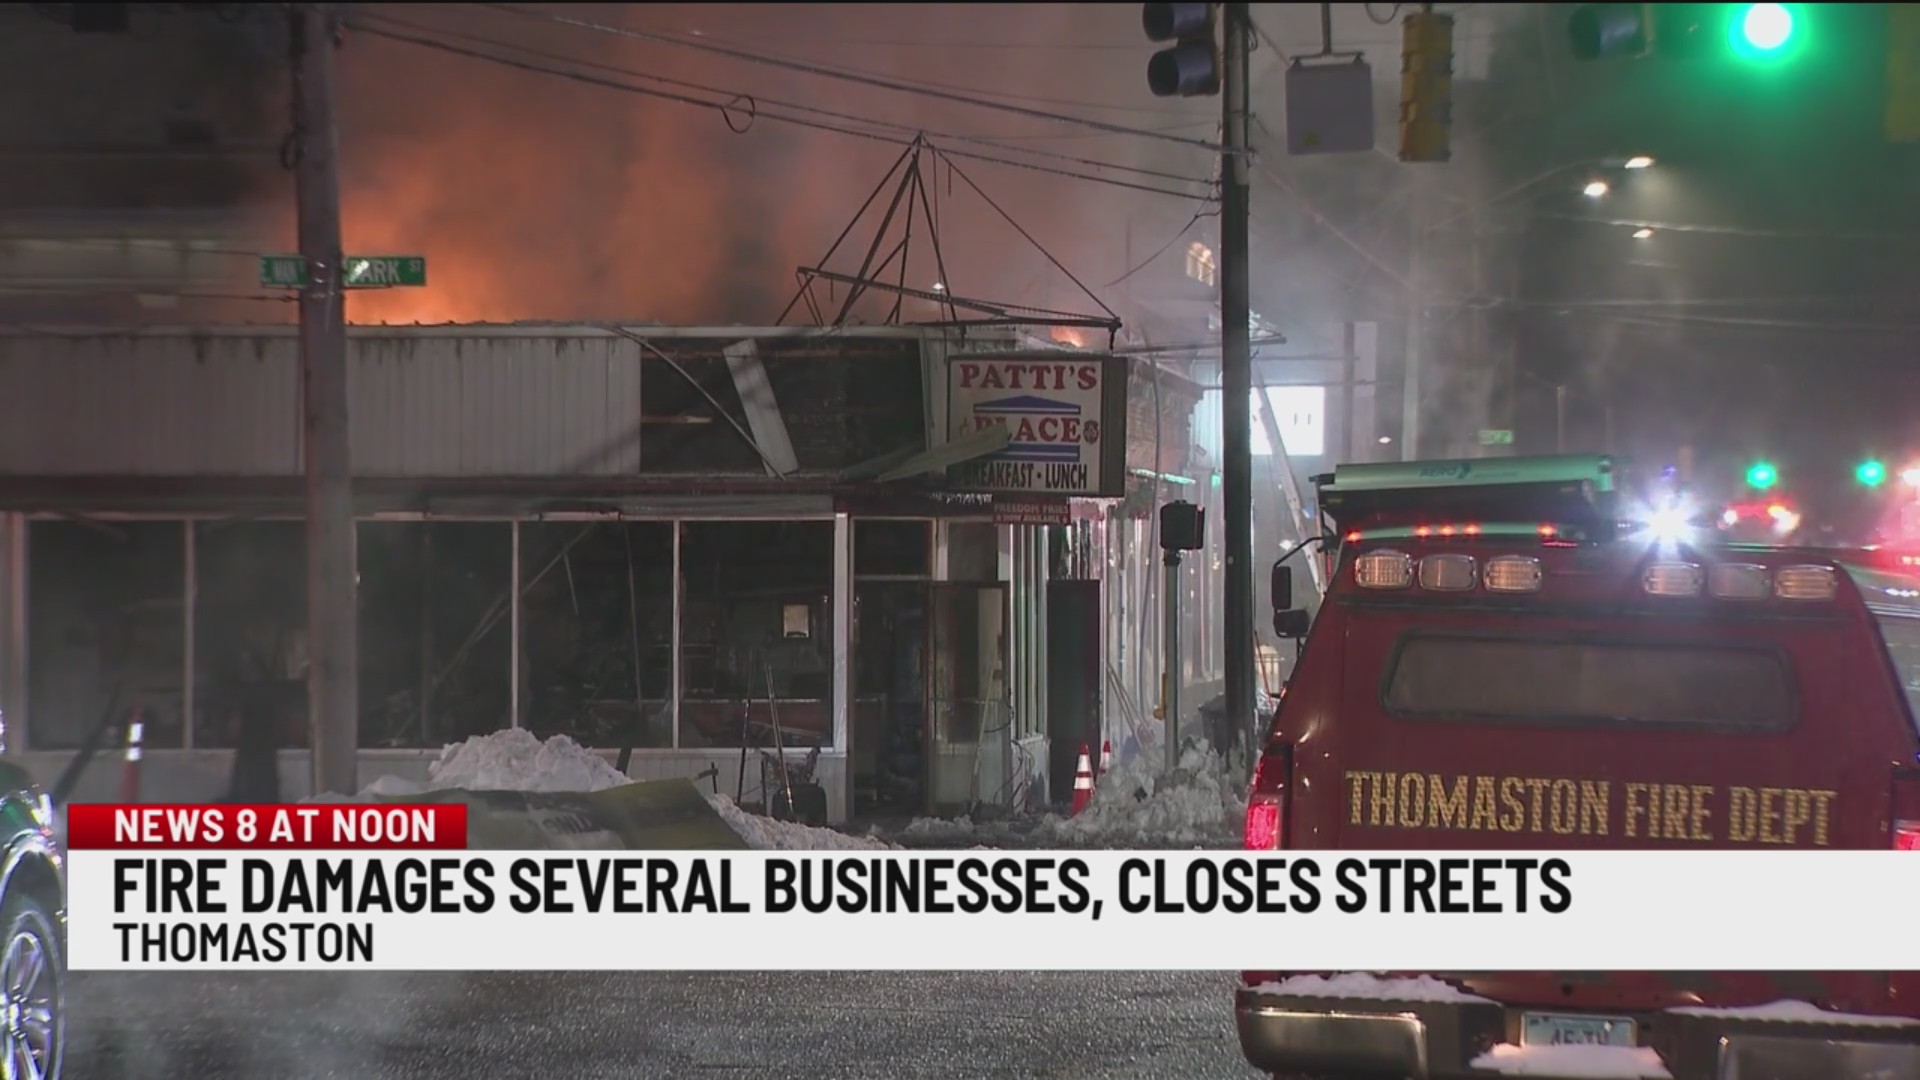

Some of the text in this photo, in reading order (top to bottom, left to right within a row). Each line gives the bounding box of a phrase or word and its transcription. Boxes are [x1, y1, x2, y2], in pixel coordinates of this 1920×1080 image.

[410, 260, 421, 272] ST
[960, 364, 1097, 389] PATTI'S
[963, 462, 1087, 489] BREAKFAST LUNCH
[994, 503, 1040, 514] FREEDOM
[1345, 770, 1837, 846] THOMASTON FIRE DEPT
